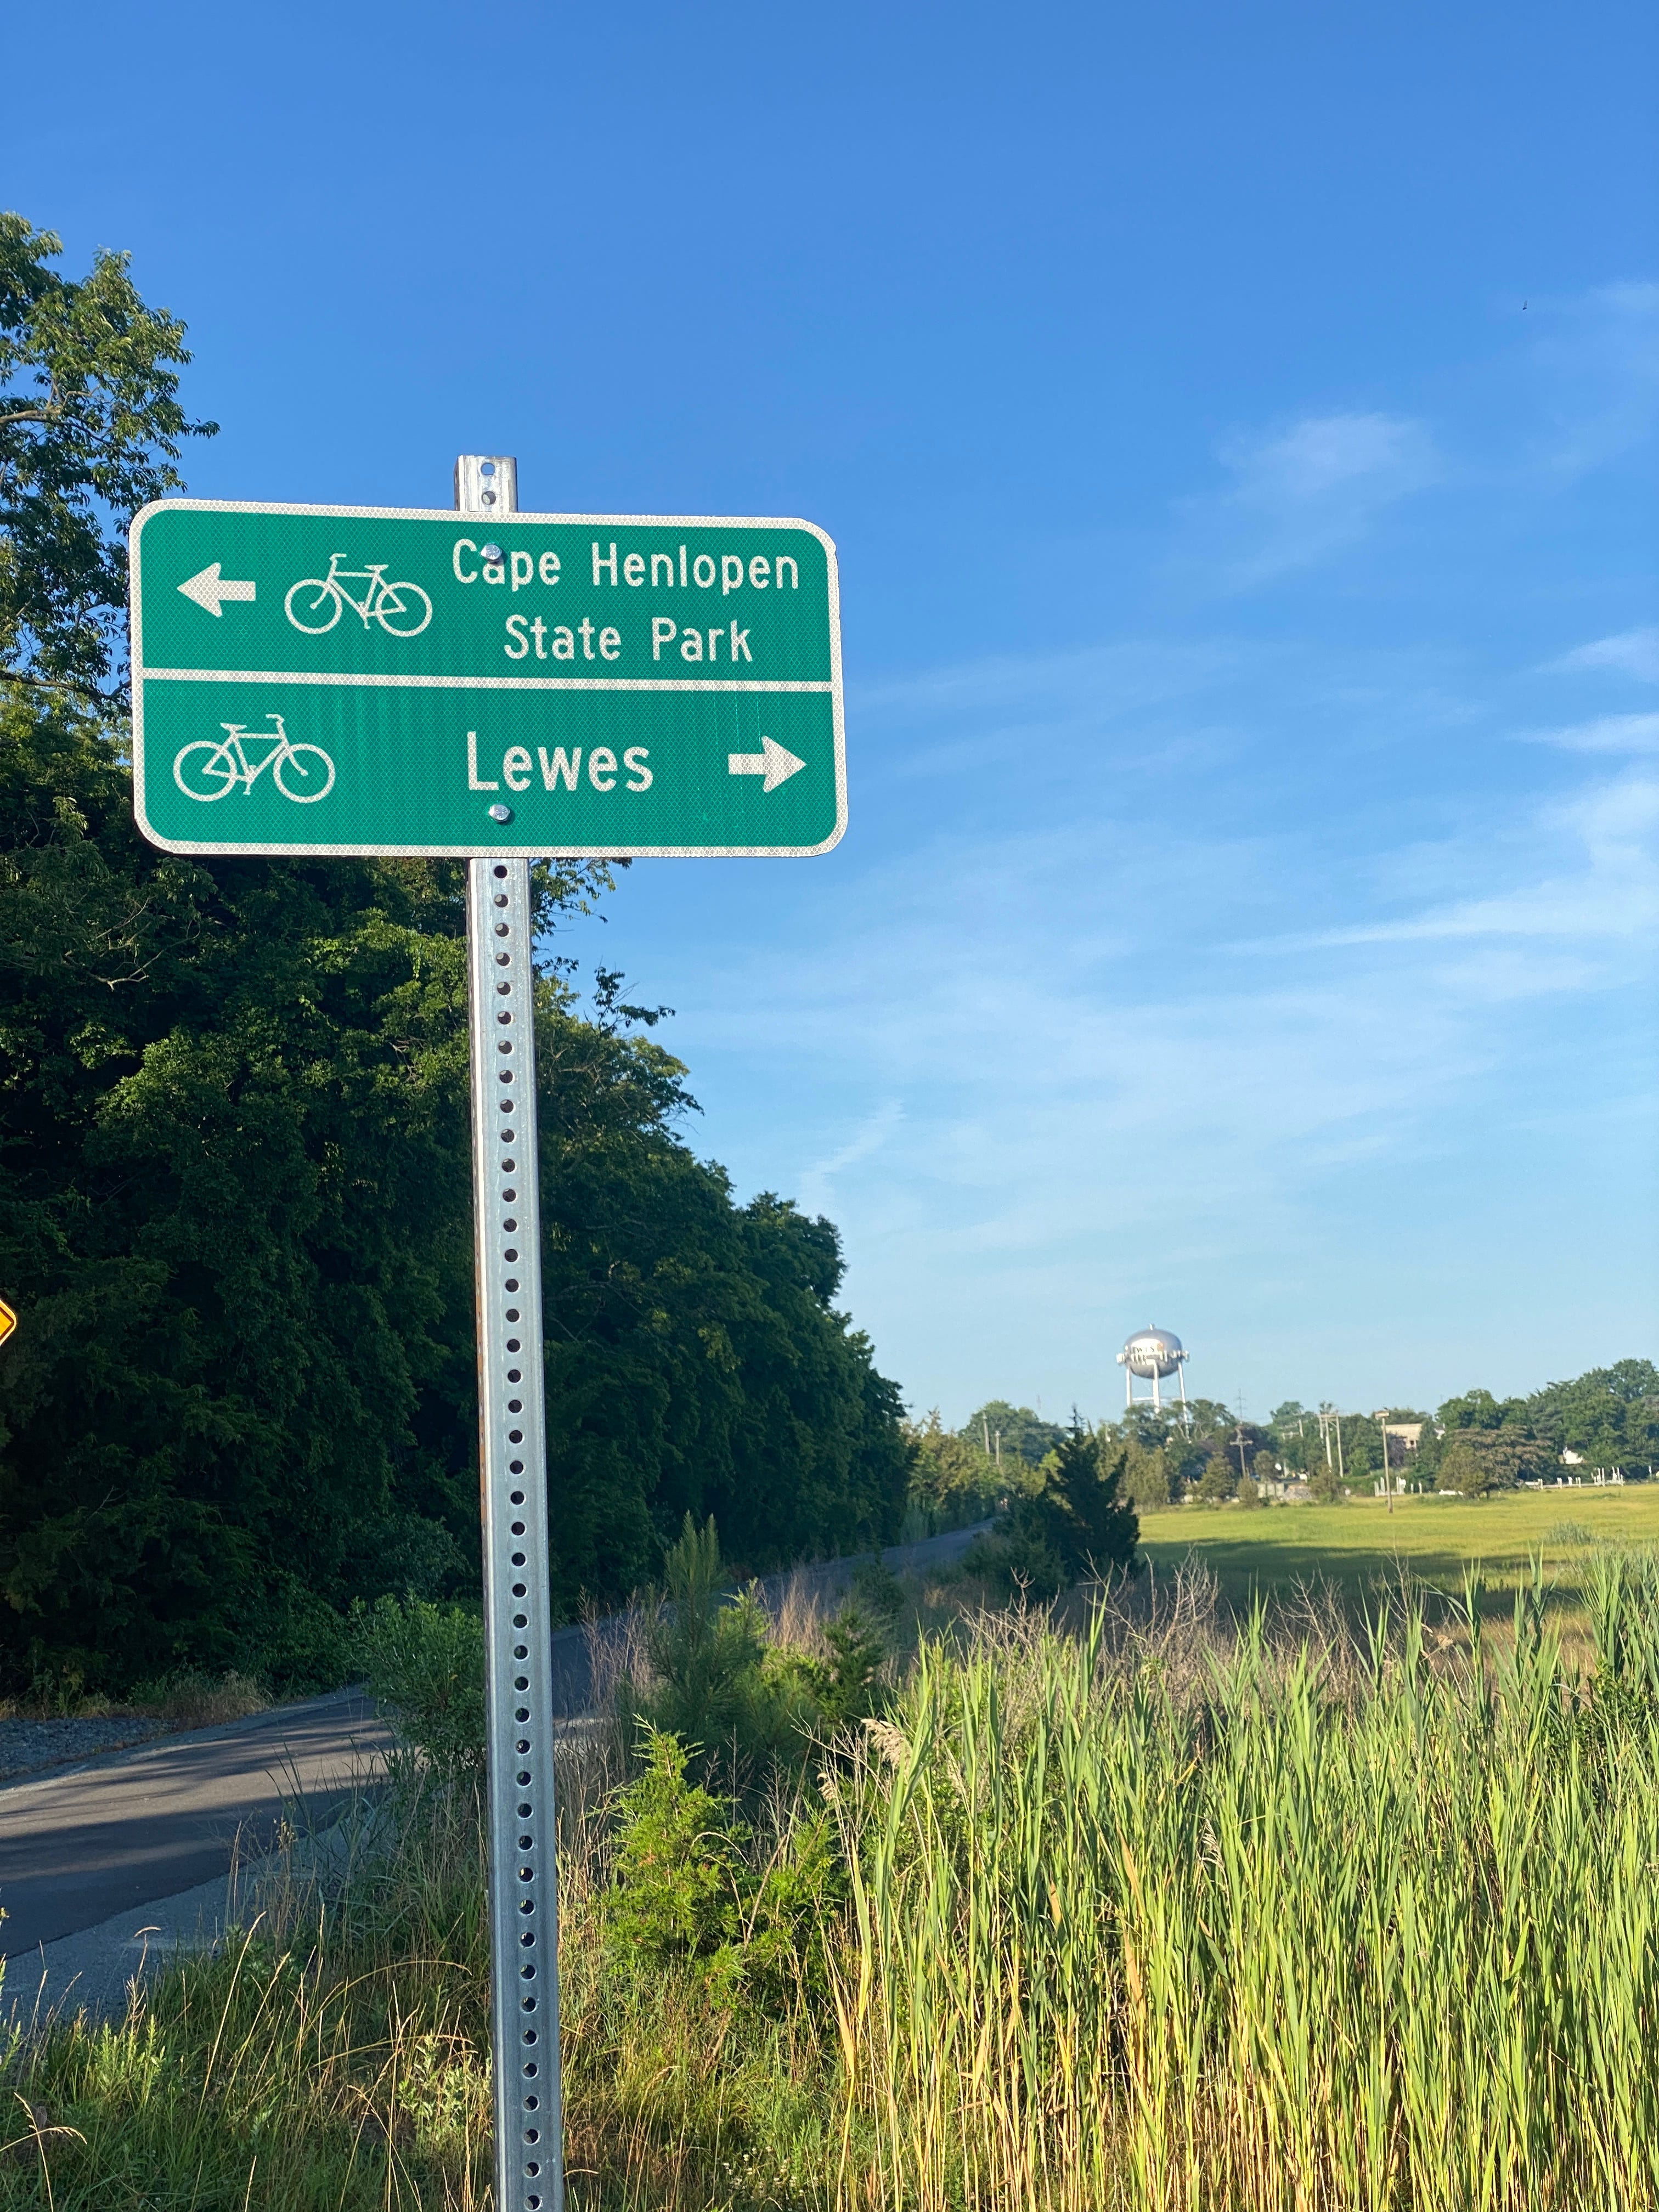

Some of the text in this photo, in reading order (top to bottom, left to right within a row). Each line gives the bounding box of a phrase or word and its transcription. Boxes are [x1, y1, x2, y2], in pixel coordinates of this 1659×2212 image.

[453, 539, 799, 596] Cape Henlopen
[504, 614, 753, 662] State Park
[467, 731, 653, 792] Lewes
